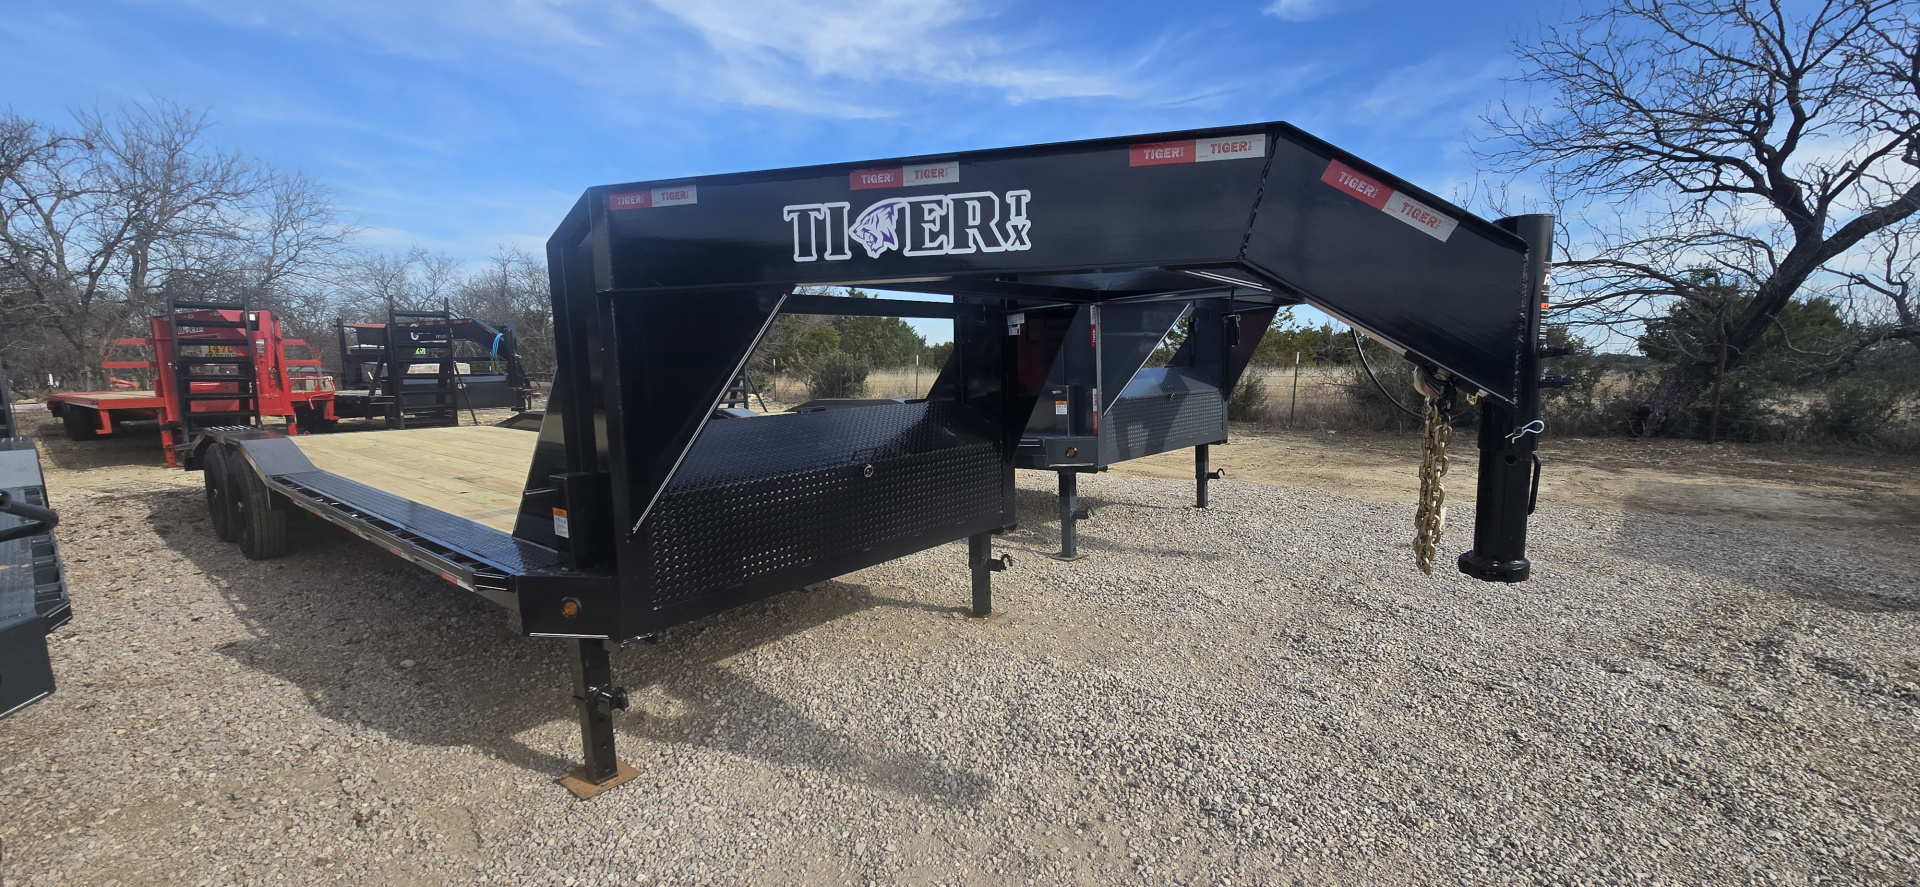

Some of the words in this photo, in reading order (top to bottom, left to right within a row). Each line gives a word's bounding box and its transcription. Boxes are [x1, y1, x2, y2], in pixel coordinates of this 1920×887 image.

[1144, 147, 1180, 160] TIGER
[1210, 141, 1248, 154] TIGER
[861, 173, 891, 184] TIGER
[914, 168, 945, 179] TIGER
[1338, 171, 1376, 196] TIGER
[616, 194, 641, 206] TIGER
[661, 190, 686, 201] TIGER
[1400, 201, 1438, 229] TIGER
[783, 190, 1008, 262] TIGER
